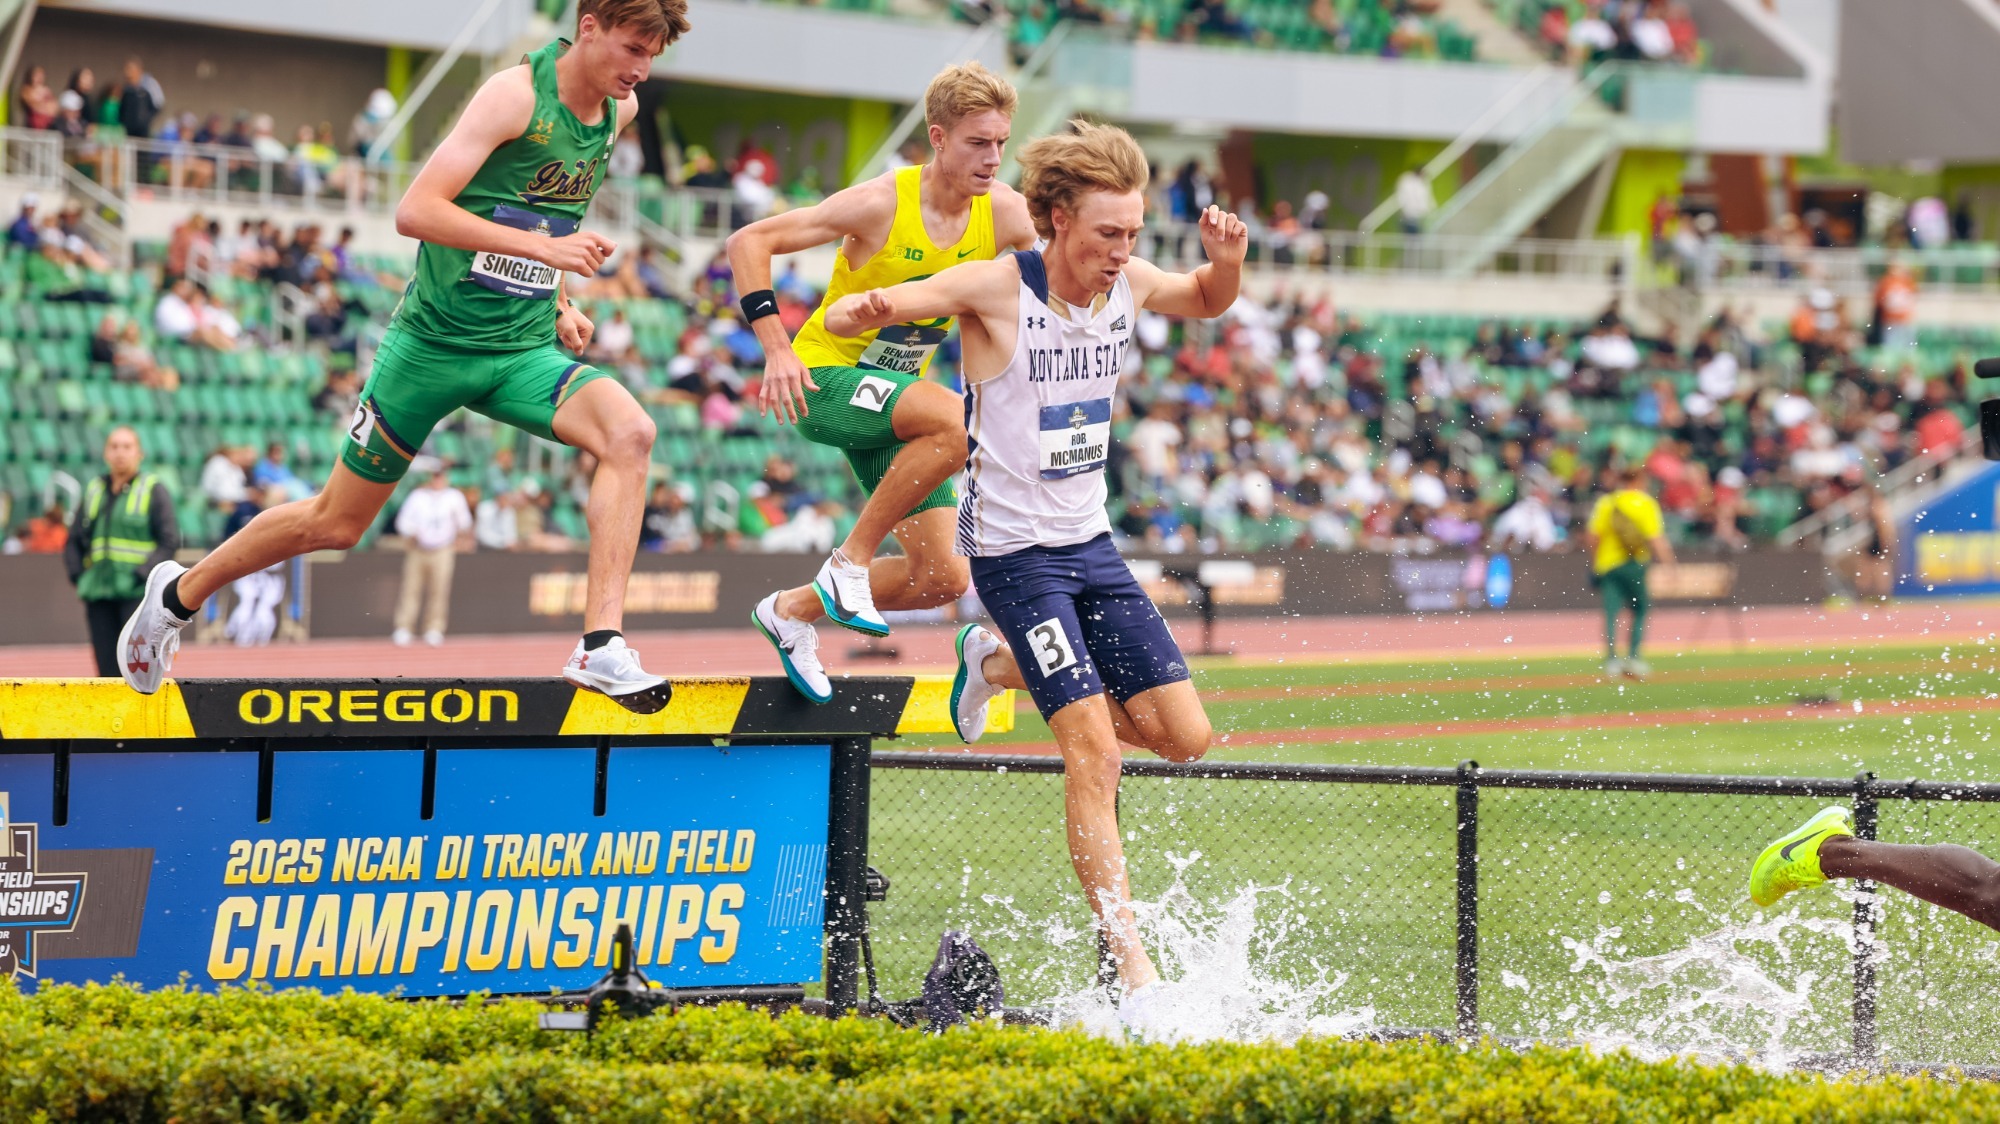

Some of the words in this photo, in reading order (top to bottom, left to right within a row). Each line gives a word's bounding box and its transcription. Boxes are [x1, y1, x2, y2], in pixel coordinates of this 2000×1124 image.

[528, 158, 597, 197] Irish
[482, 253, 557, 285] SINGLETON
[876, 355, 918, 372] BALAZS
[883, 346, 925, 360] BENJAMIN
[856, 383, 891, 405] 2
[350, 406, 367, 441] 2
[1071, 433, 1087, 446] ROB
[1050, 444, 1103, 467] MCMANUS
[1034, 625, 1065, 670] 3
[238, 688, 519, 725] OREGON
[223, 838, 327, 885] 2025
[331, 836, 424, 882] NCAA
[435, 834, 475, 880] DI
[482, 832, 589, 878] TRACK
[590, 831, 661, 876] AND
[665, 829, 756, 874] FIELD
[206, 883, 746, 980] CHAMPIONSHIPS
